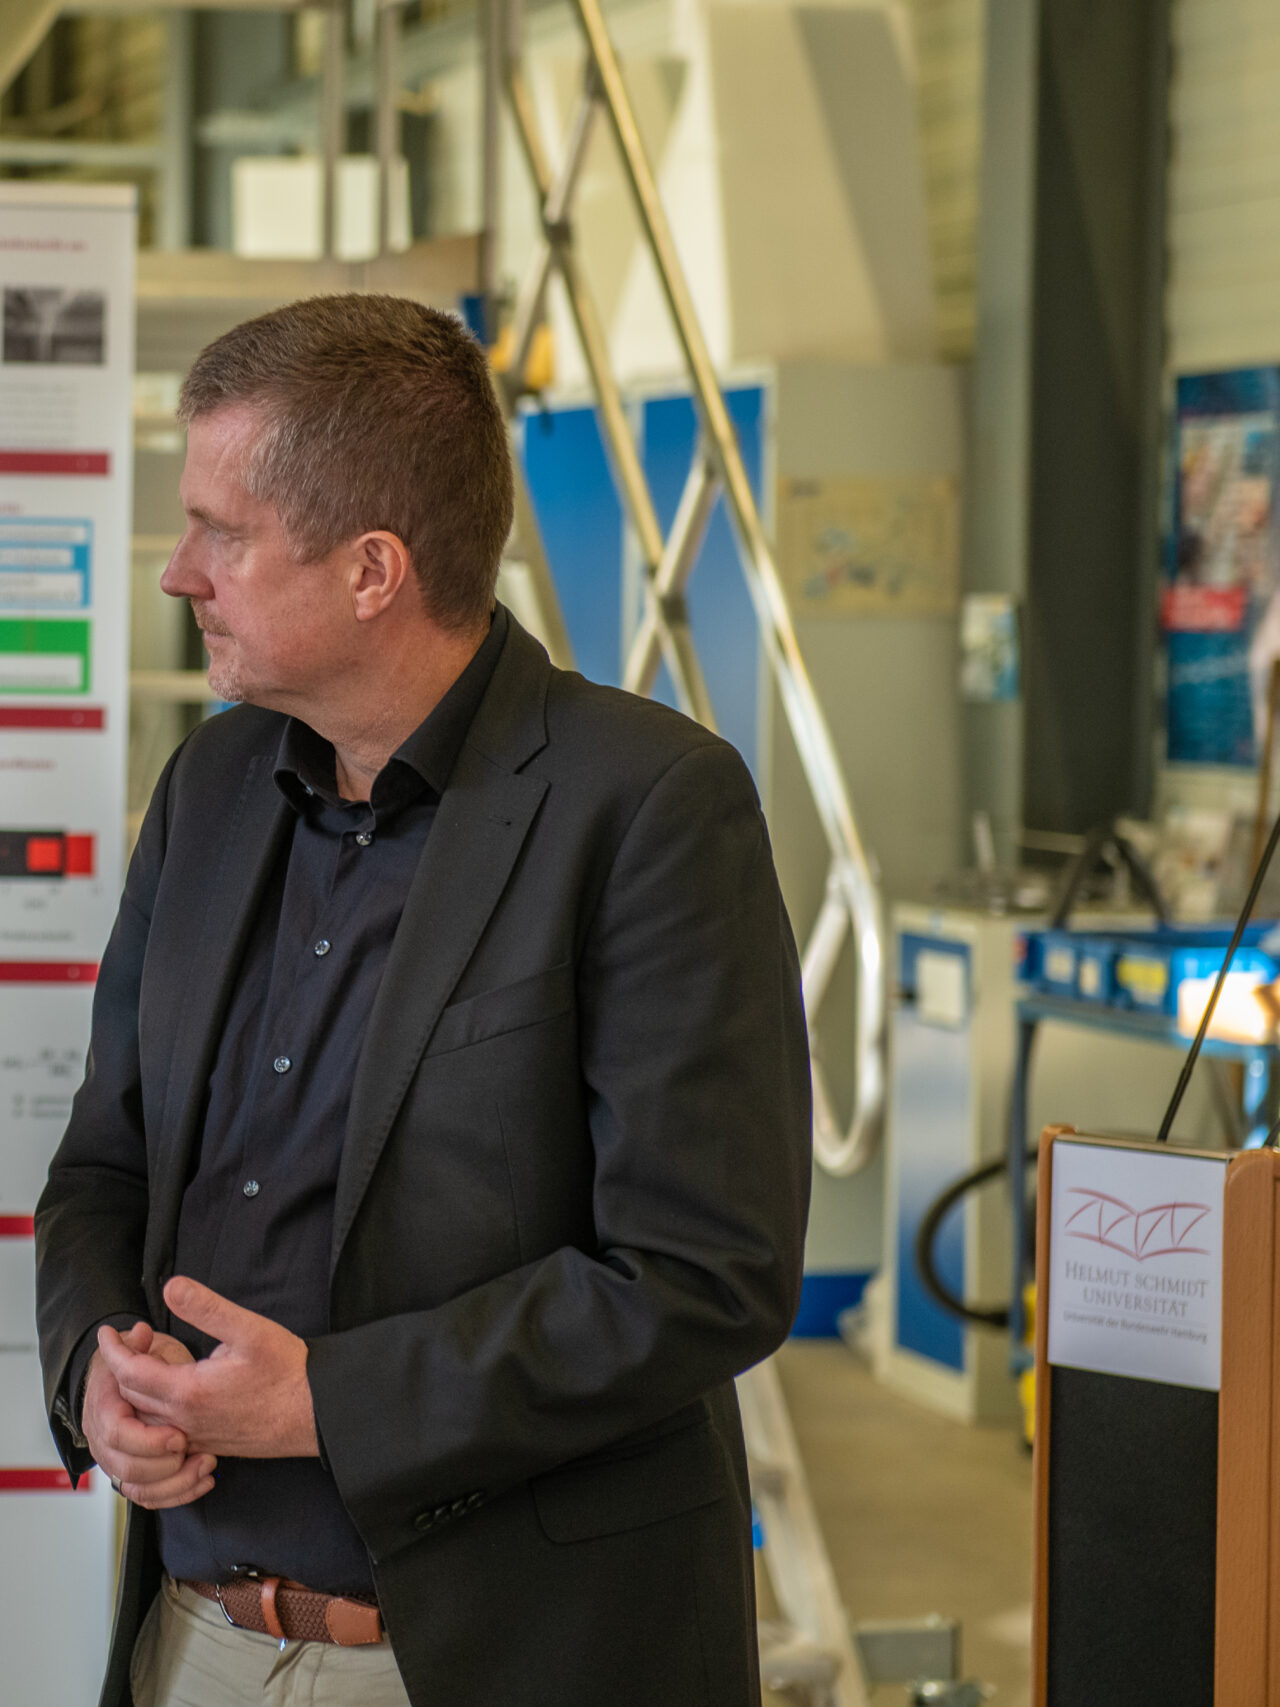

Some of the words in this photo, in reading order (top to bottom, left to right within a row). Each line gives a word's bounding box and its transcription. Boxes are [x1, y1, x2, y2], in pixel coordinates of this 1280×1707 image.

[1065, 1260, 1131, 1288] HELMUT
[1134, 1272, 1209, 1299] SCHMIDT
[1082, 1286, 1189, 1318] UNIVERSITÄT
